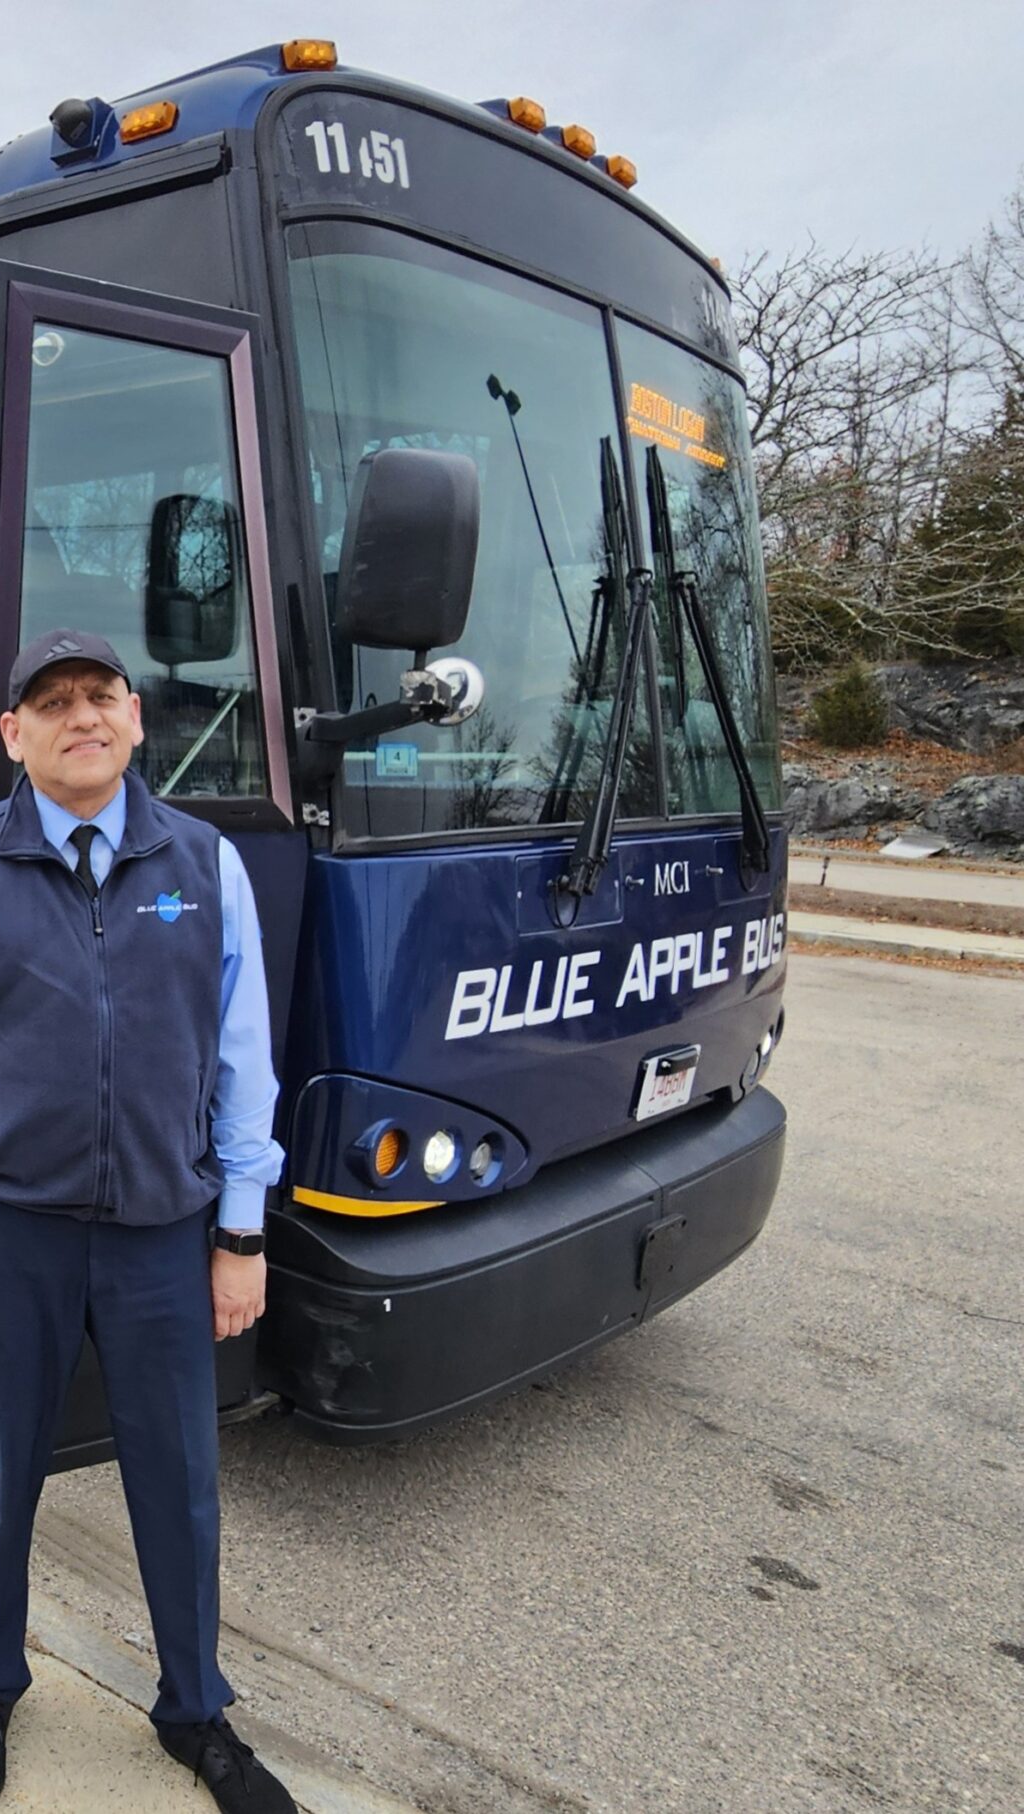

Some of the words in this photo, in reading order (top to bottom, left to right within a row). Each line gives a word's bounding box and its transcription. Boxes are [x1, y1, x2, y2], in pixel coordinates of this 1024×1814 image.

[654, 860, 690, 896] MCI
[444, 950, 601, 1040] BLUE
[615, 926, 732, 1008] APPLE
[741, 913, 784, 976] BUS
[383, 1298, 392, 1312] 1
